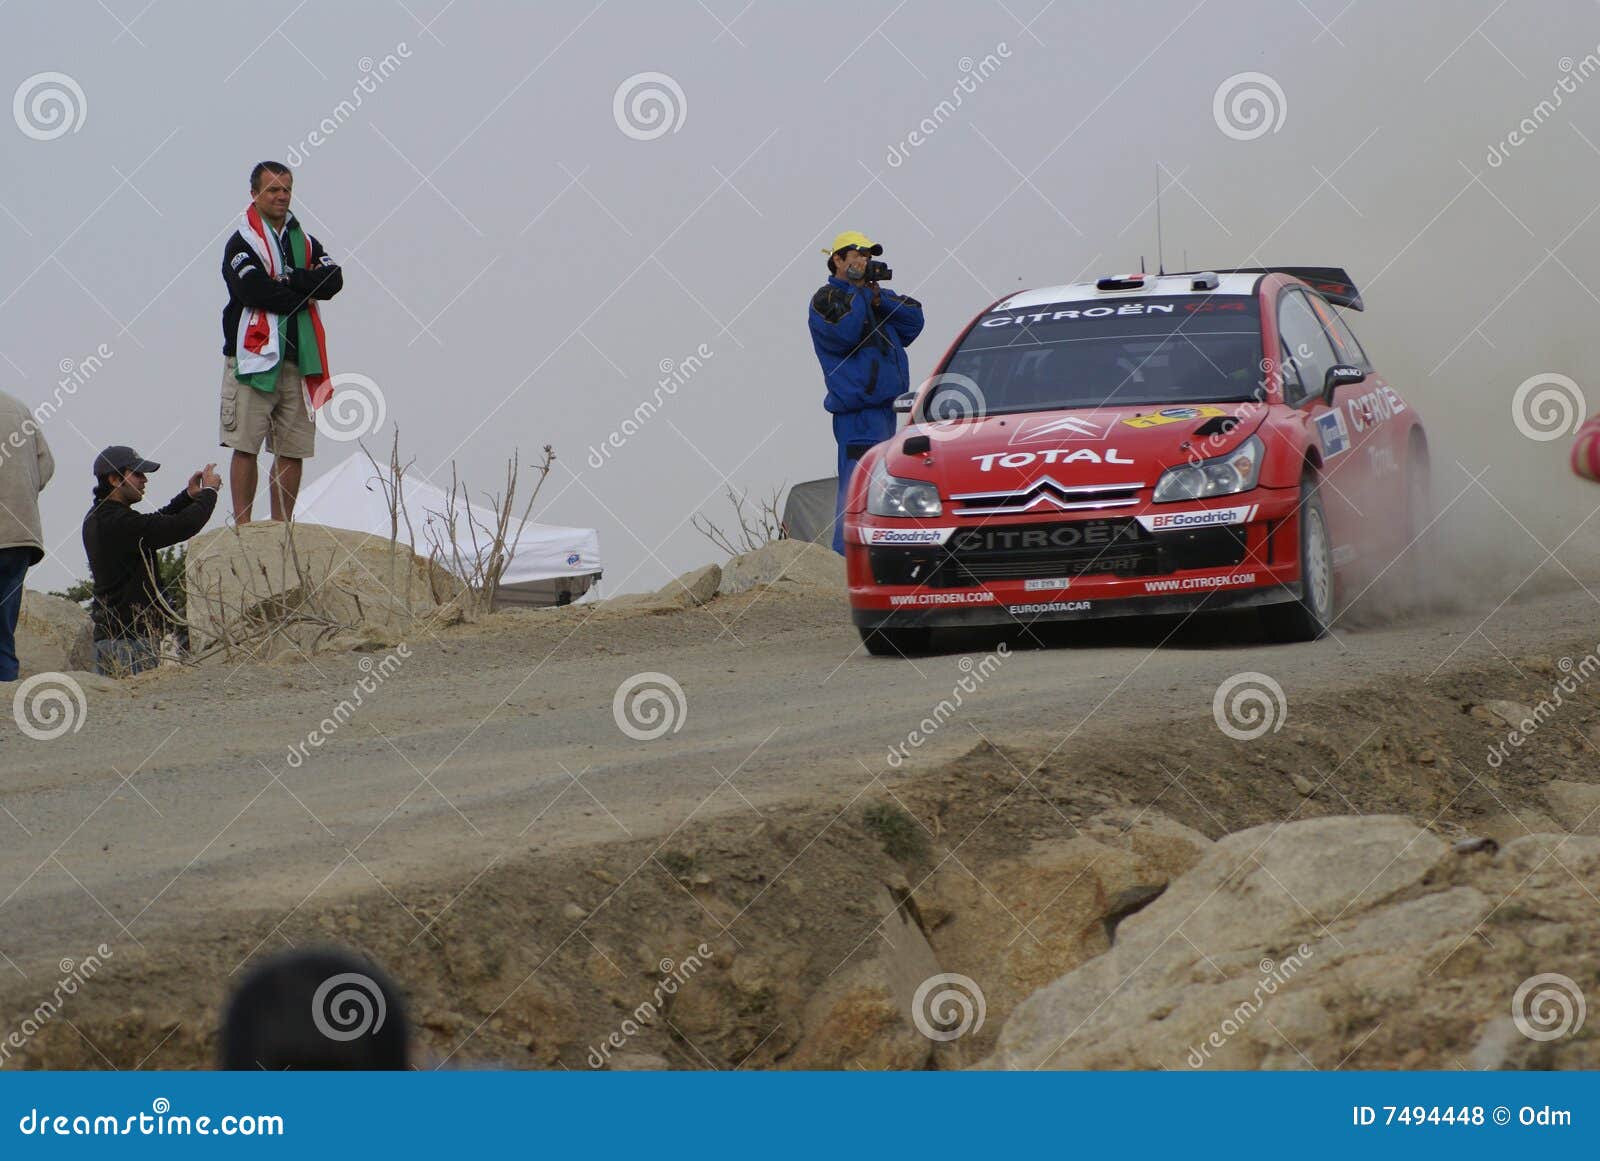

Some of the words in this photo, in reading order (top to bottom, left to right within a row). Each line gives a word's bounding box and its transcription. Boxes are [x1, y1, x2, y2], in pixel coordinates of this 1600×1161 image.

[981, 303, 1174, 327] CITROËN
[971, 448, 1134, 472] TOTAL
[1153, 510, 1237, 527] BFGoodrich
[871, 530, 941, 542] BFGoodrich
[953, 520, 1139, 550] CITROËN
[1145, 573, 1255, 592] WWW.CITROEN.COM
[890, 592, 994, 605] WWW.CITROEN.COM
[1010, 601, 1091, 614] EURODATACAR
